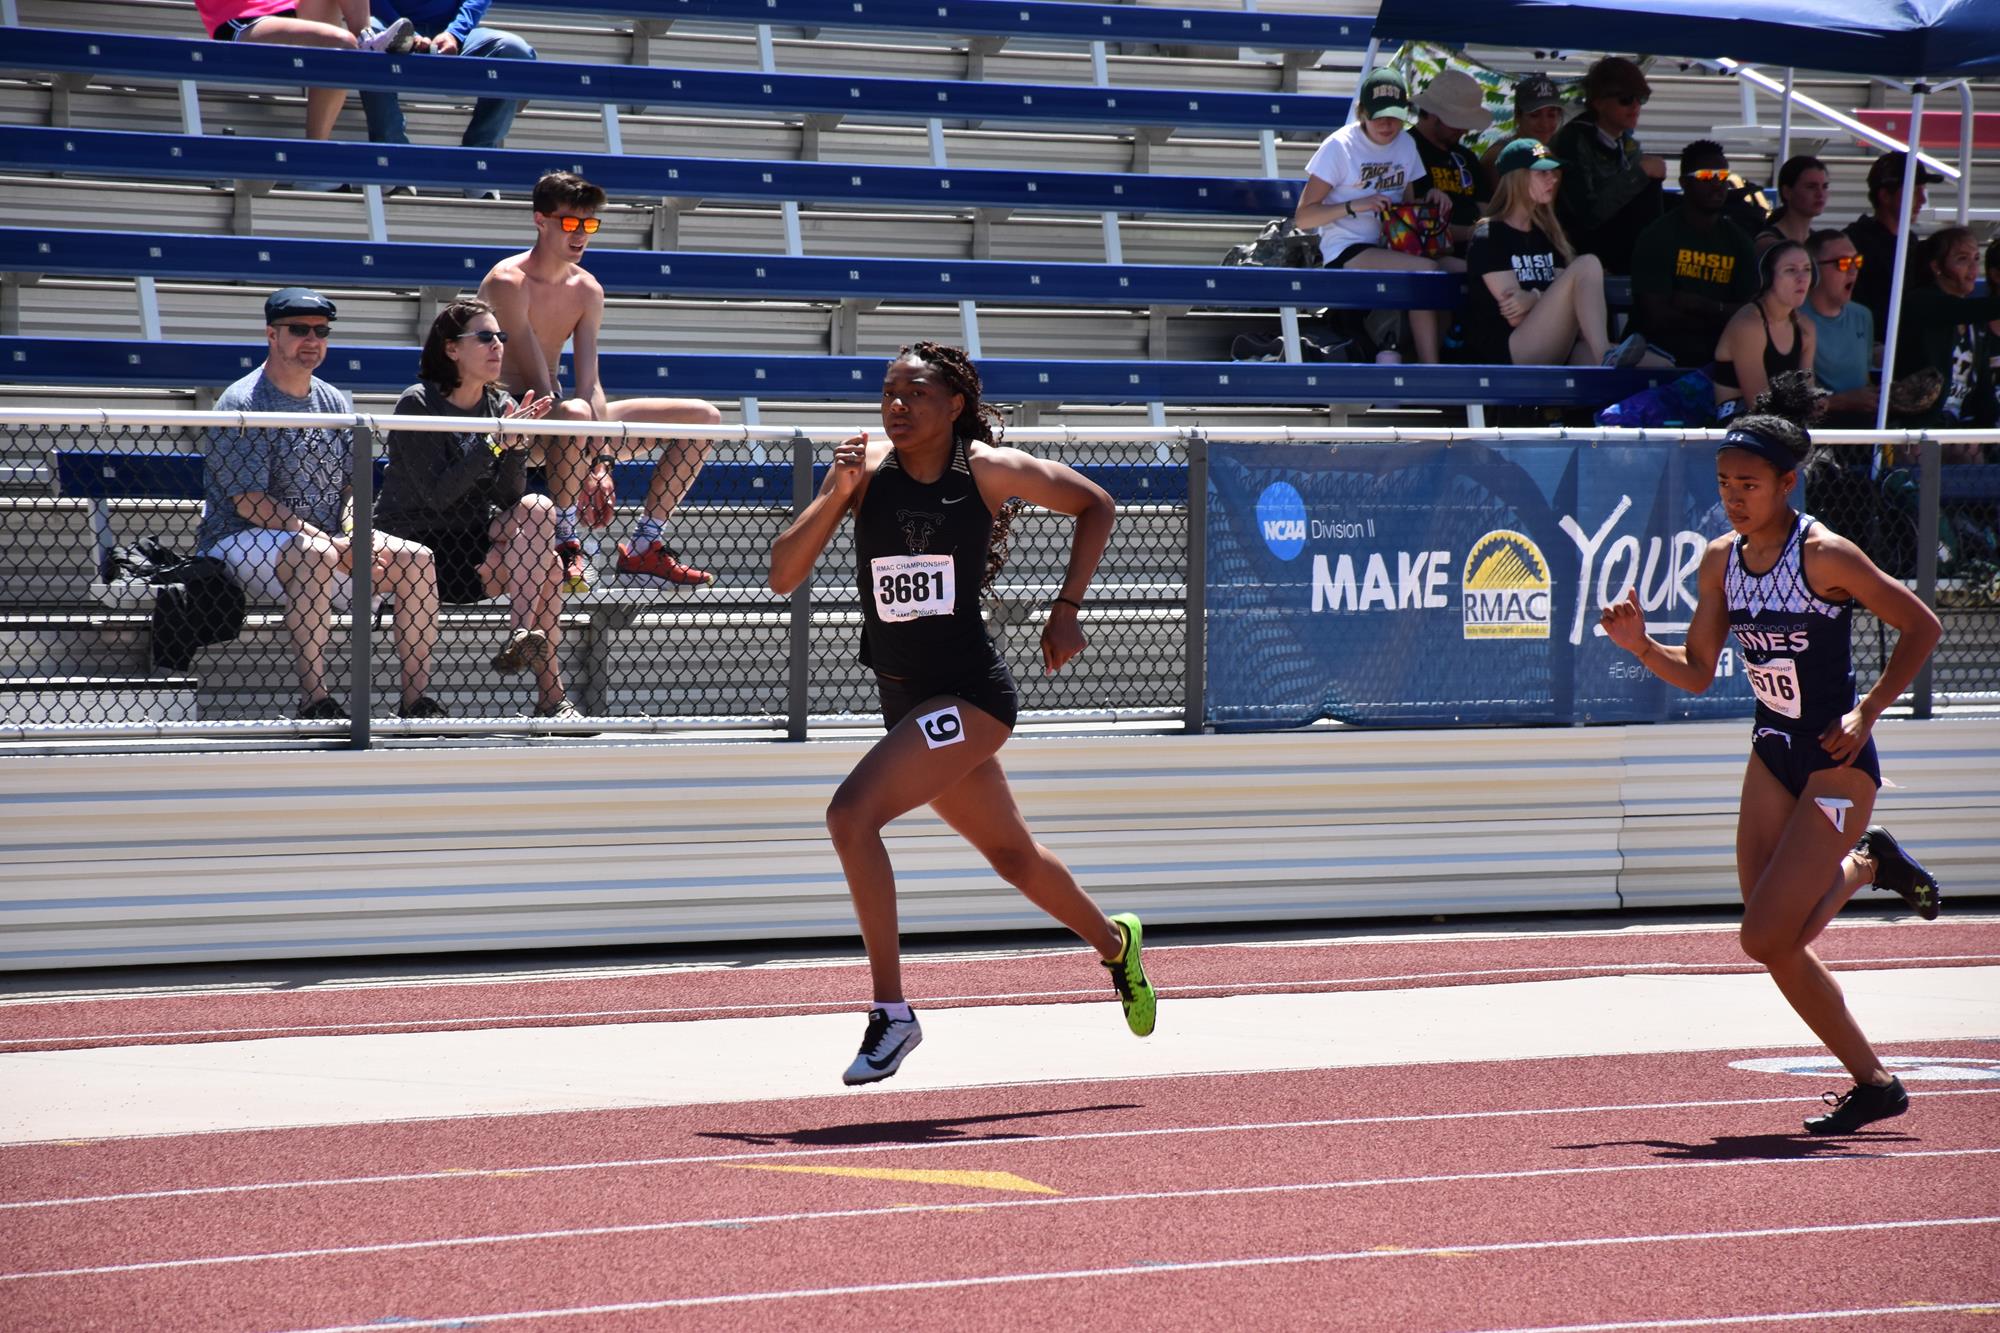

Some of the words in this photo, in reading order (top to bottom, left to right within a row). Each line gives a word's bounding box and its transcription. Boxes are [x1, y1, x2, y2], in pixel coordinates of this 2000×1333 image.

[292, 57, 304, 68] 10
[391, 63, 401, 74] 11
[487, 69, 498, 79] 12
[580, 75, 591, 85] 13
[671, 79, 682, 89] 14
[762, 84, 773, 94] 15
[850, 87, 861, 98] 16
[476, 160, 488, 171] 10
[572, 164, 584, 175] 11
[667, 168, 679, 179] 12
[940, 179, 951, 189] 15
[1027, 182, 1037, 192] 16
[1511, 253, 1553, 268] BHSU
[1678, 249, 1736, 269] BHSU
[660, 264, 672, 275] 10
[755, 267, 767, 278] 11
[849, 270, 860, 280] 12
[1676, 263, 1701, 279] TRACK
[1030, 275, 1041, 285] 14
[1119, 276, 1129, 287] 15
[1205, 279, 1217, 289] 16
[1264, 520, 1306, 541] NCAA
[1311, 519, 1365, 539] Division
[896, 560, 950, 570] CHAMPIONSHIP
[1311, 551, 1450, 612] MAKE
[880, 571, 944, 605] 3681
[1464, 592, 1549, 622] RMAC
